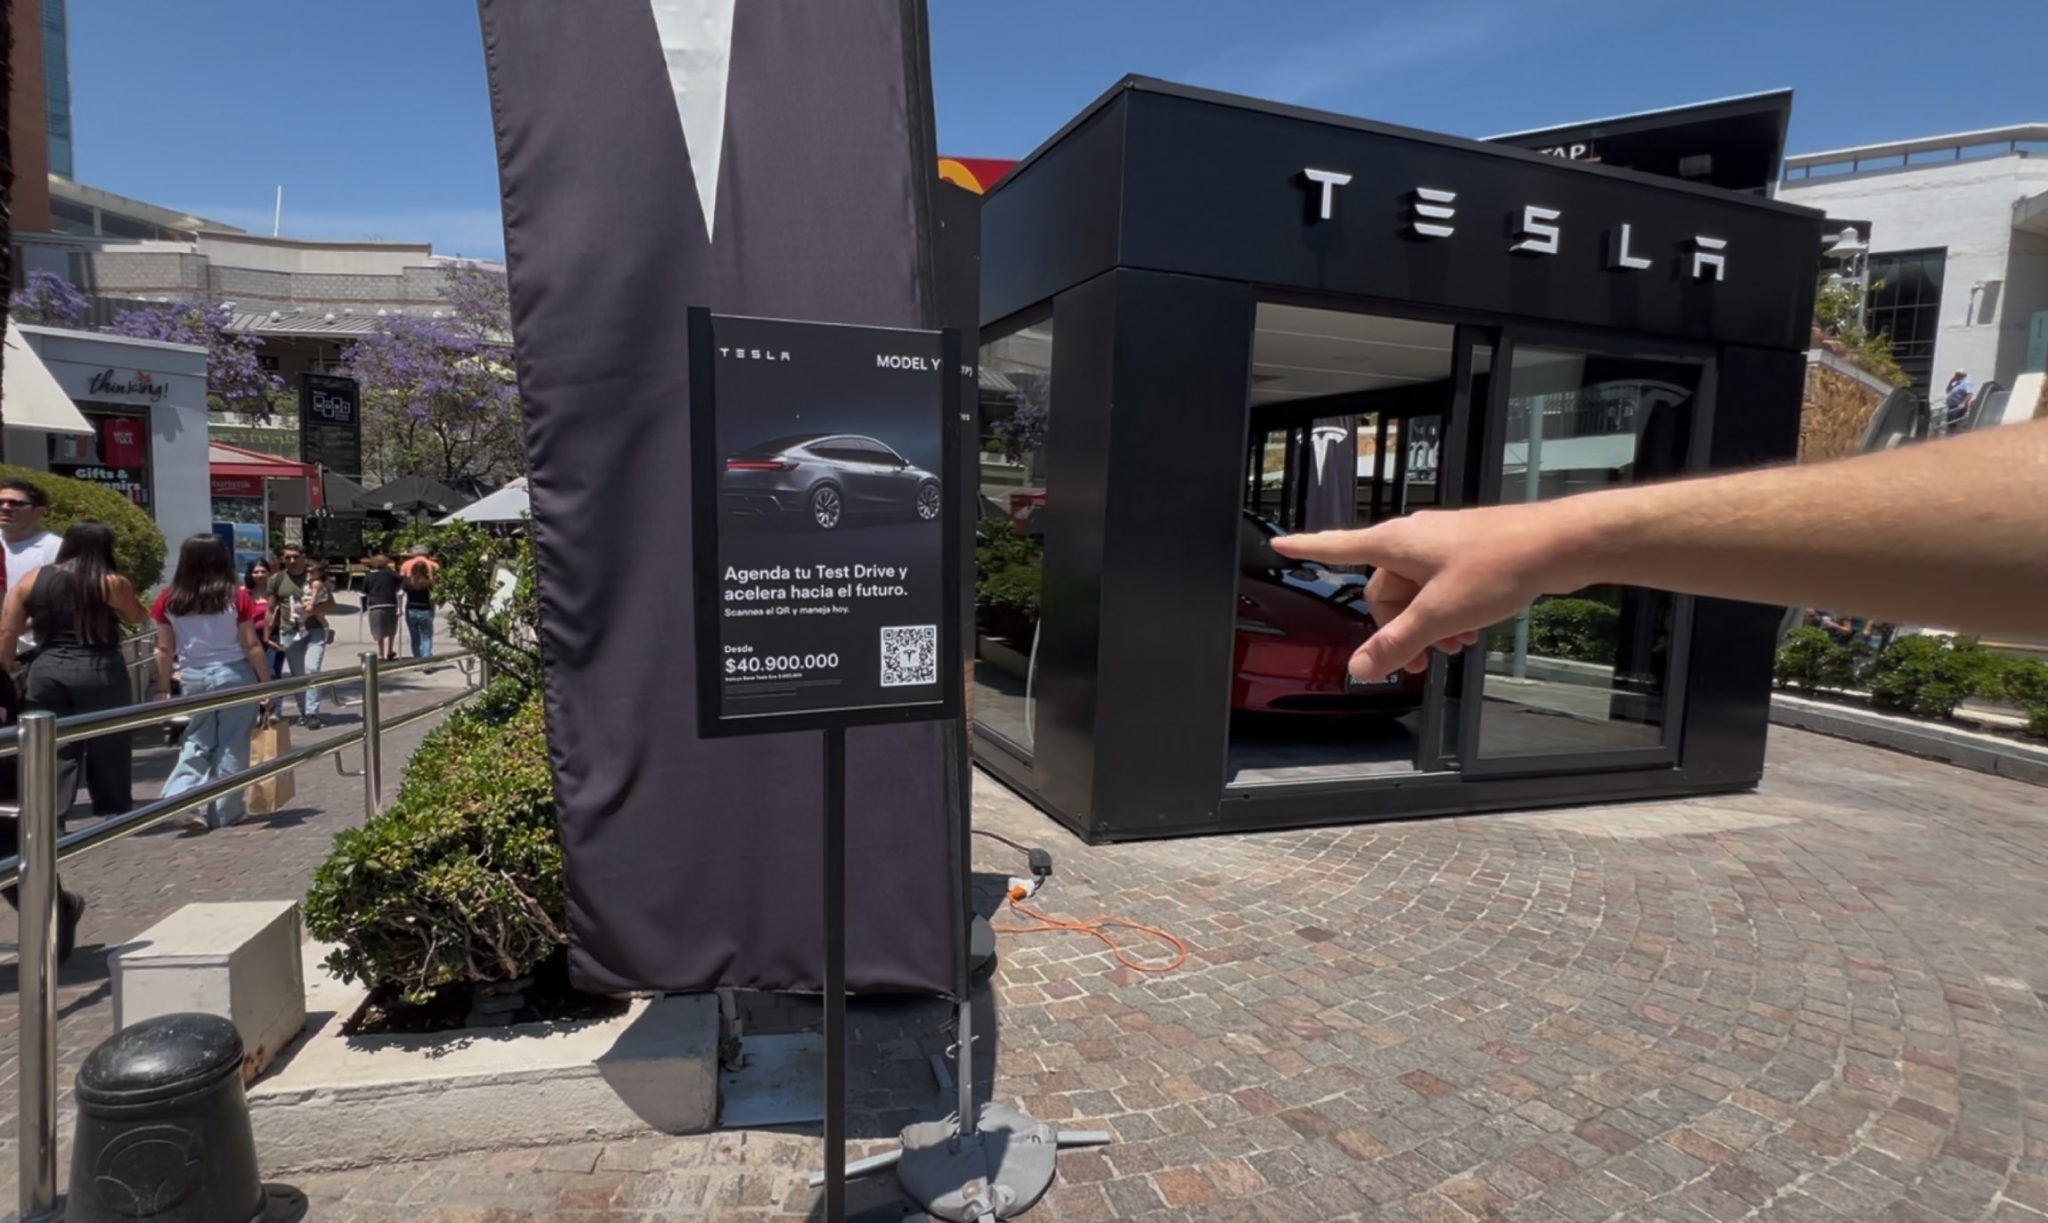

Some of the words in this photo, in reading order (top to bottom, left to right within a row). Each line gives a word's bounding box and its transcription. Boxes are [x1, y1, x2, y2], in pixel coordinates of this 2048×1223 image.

[1302, 167, 1728, 282] TESLA
[719, 347, 791, 362] TESLA
[876, 354, 928, 371] MODEL
[930, 357, 942, 371] Y
[75, 468, 115, 479] Gifts
[117, 469, 128, 479] &
[724, 565, 790, 584] Agenda
[794, 565, 811, 580] tu
[816, 564, 849, 579] Test
[854, 563, 895, 579] Drive
[898, 566, 908, 581] y
[724, 585, 786, 601] acelera
[790, 584, 834, 599] hacia
[838, 584, 852, 598] el
[855, 583, 908, 598] futuro.
[766, 606, 774, 616] el
[776, 606, 790, 617] QR
[791, 607, 798, 617] y
[800, 606, 831, 616] maneja
[832, 604, 850, 616] hoy.
[724, 644, 754, 654] Desde
[725, 653, 839, 674] $40.900.000
